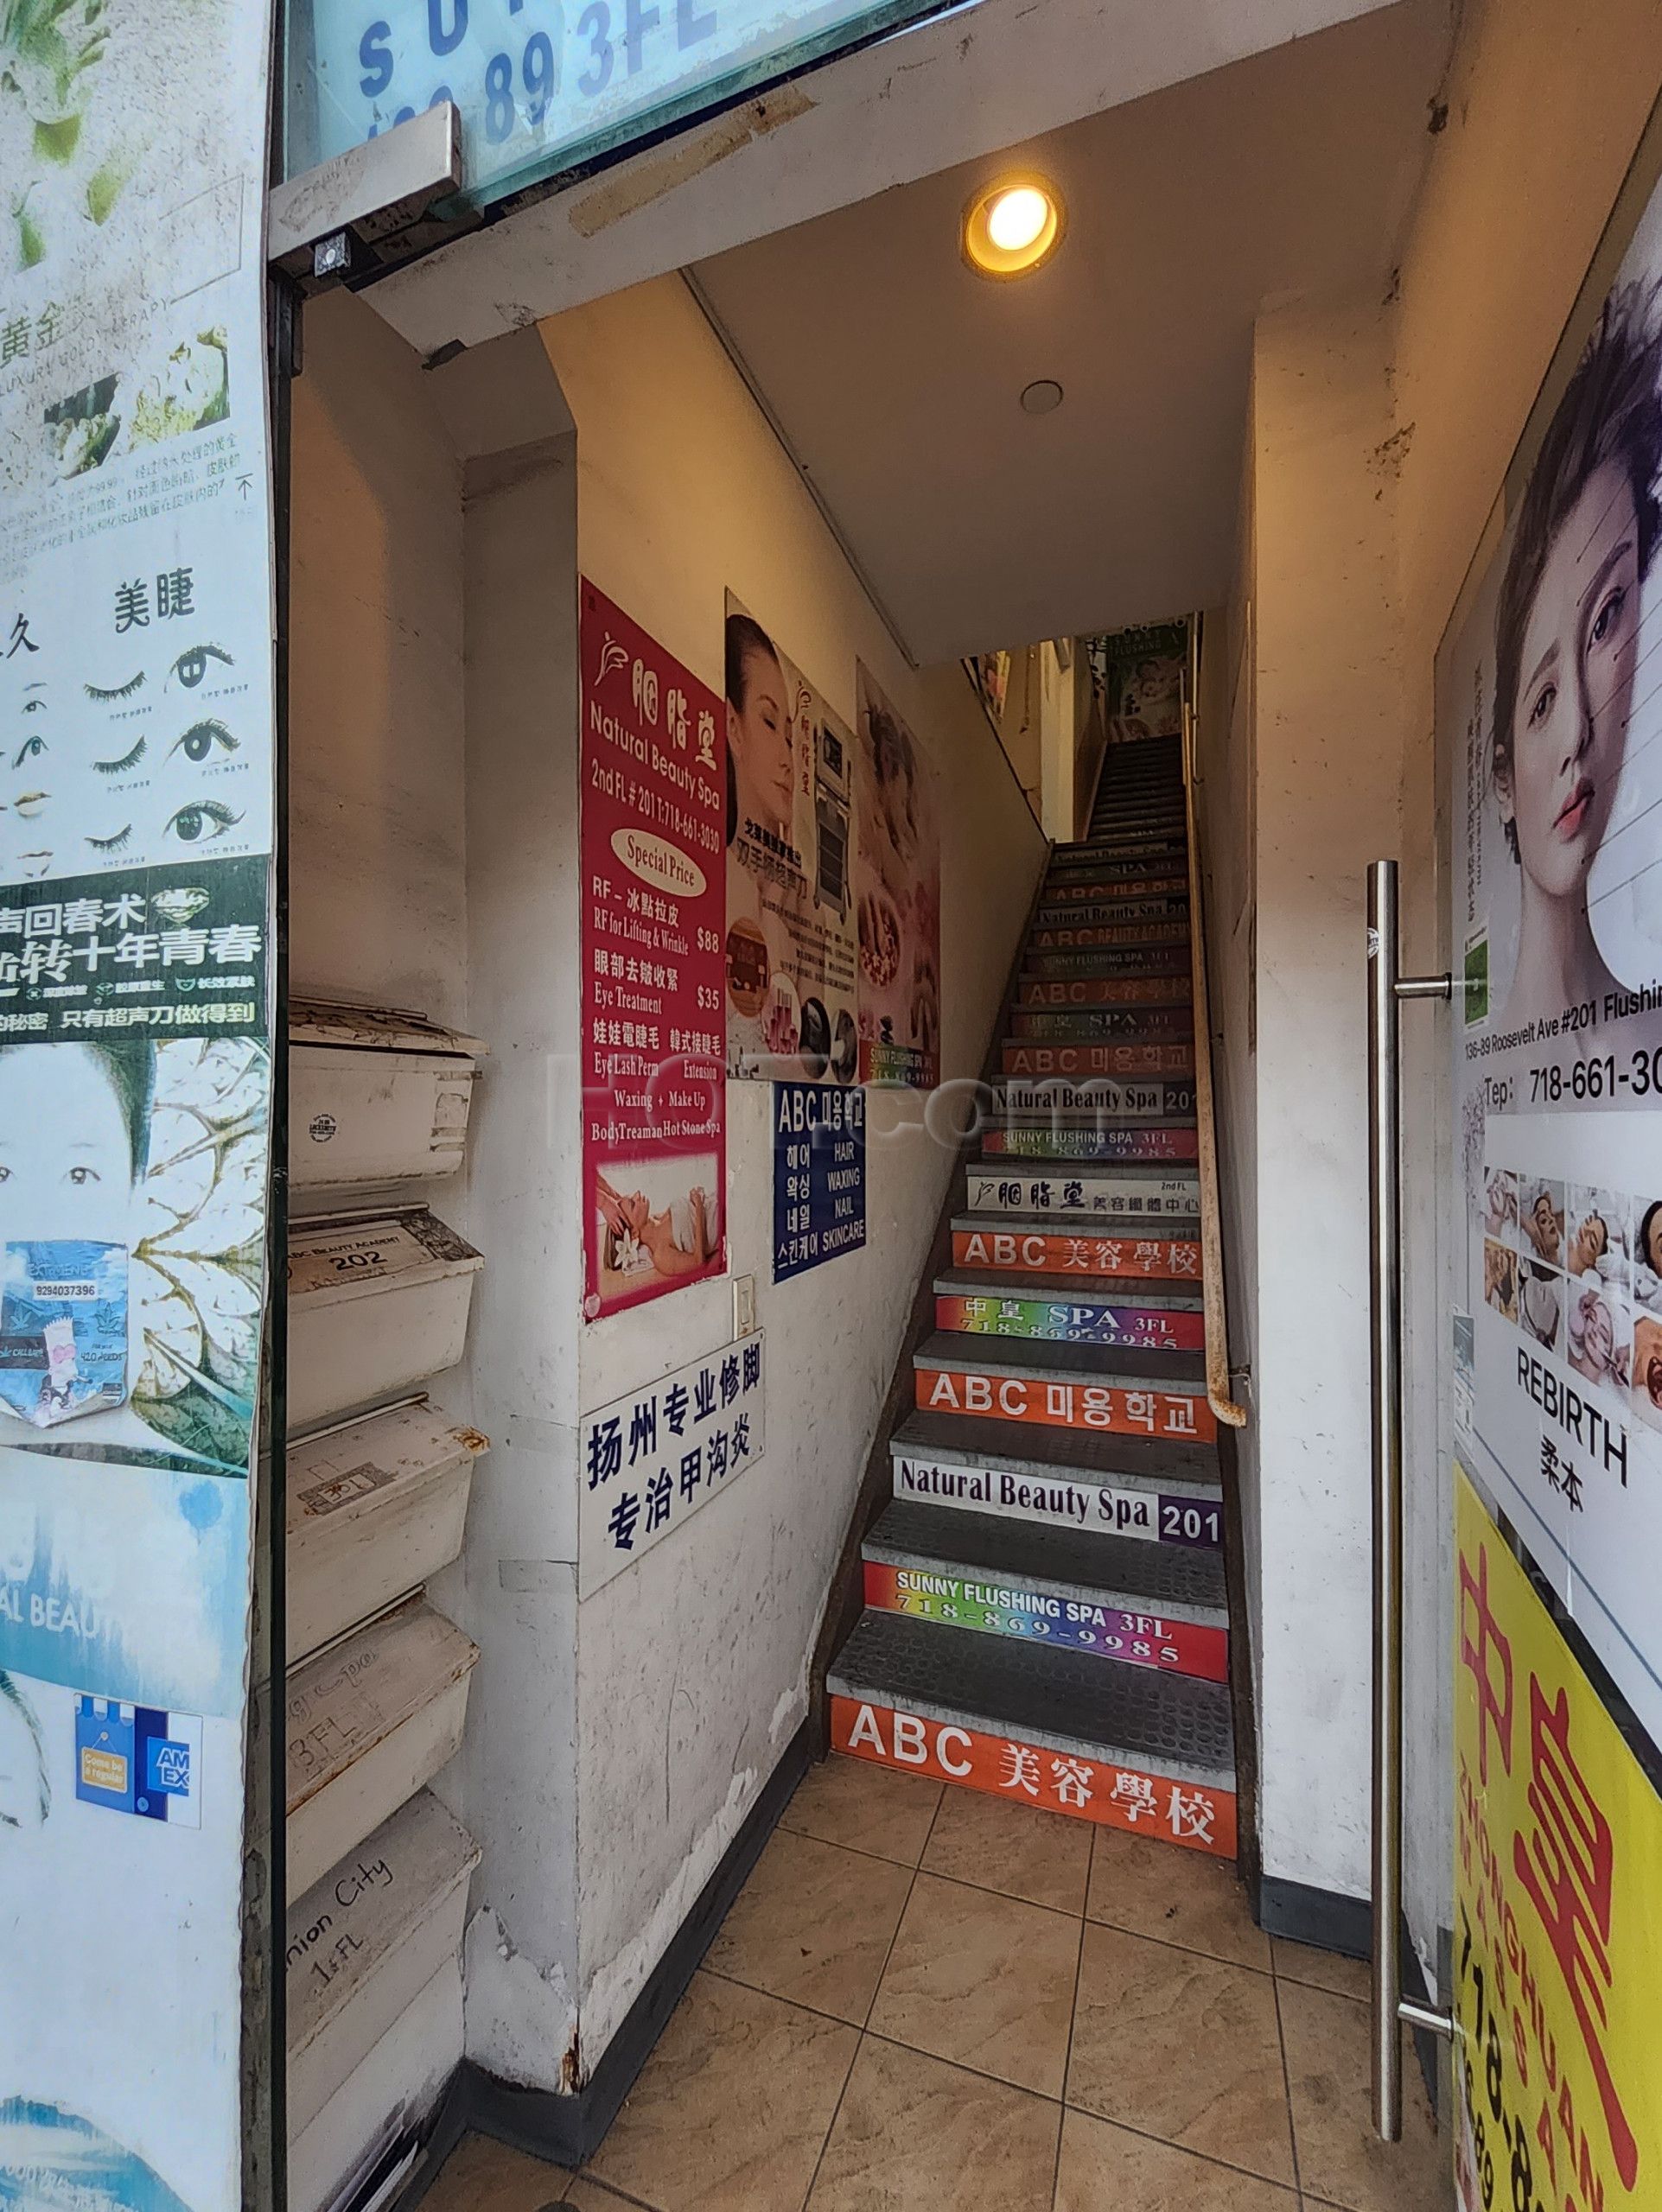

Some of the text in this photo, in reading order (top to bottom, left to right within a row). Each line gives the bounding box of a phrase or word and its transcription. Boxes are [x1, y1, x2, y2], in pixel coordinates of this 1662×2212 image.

[115, 567, 195, 633] 美睫
[0, 613, 40, 658] 久
[591, 701, 720, 810] Natural Beauty Spa
[592, 758, 613, 796] 2nd
[615, 772, 627, 804] FL
[627, 835, 667, 874] Special
[669, 854, 695, 887] Price
[593, 875, 611, 899] RF
[594, 906, 608, 931] RF
[609, 911, 621, 938] for
[623, 917, 652, 950] Lifting
[661, 930, 689, 956] Wrinkle
[697, 927, 719, 954] $88
[1038, 928, 1093, 947] ABC
[594, 982, 663, 1015] Eye Treatment
[697, 985, 720, 1011] $35
[1028, 982, 1087, 1004] ABC
[60, 1002, 255, 1030] 只有超声刀做得到
[1492, 1021, 1536, 1052] Roosevelt
[1538, 1018, 1558, 1041] Ave
[1561, 1001, 1596, 1033] #201
[594, 1052, 717, 1080] Eye Lash Perm Extension
[1012, 1048, 1079, 1073] ABC
[614, 1090, 705, 1113] Waxing Make Up
[779, 1090, 863, 1133] ABC 미용학교
[997, 1088, 1057, 1109] Natural
[1062, 1088, 1121, 1112] Beauty
[1126, 1087, 1157, 1109] Spa
[663, 1120, 680, 1137] Hot
[681, 1119, 705, 1136] Stone
[705, 1118, 721, 1139] Spa
[1003, 1132, 1042, 1144] SUNNY
[1046, 1132, 1105, 1144] FLUSHING
[1109, 1132, 1133, 1143] SPA
[786, 1141, 855, 1170] 헤어 HAIR
[827, 1167, 860, 1192] WAXING
[786, 1197, 854, 1233] 네일 NAIL
[328, 1251, 388, 1271] 202
[778, 1219, 864, 1269] 스킨케어 SKINCARE
[964, 1234, 1197, 1274] ABC 美容學校
[1048, 1305, 1122, 1329] SPA
[1135, 1318, 1175, 1334] 3FL
[587, 1341, 761, 1491] 扬州专业修脚
[929, 1373, 1198, 1434] ABC 미용학교
[1518, 1346, 1627, 1489] REBIRTH
[608, 1413, 750, 1550] 专治甲沟炎
[901, 1460, 1219, 1542] Natural Beauty Spa 201
[896, 1572, 1172, 1640] SUNNY FLUSHING SPA 3FL
[895, 1594, 1180, 1662] 718-869-9985
[848, 1705, 1215, 1845] ABC 美容學校
[286, 1859, 393, 1973] nion City
